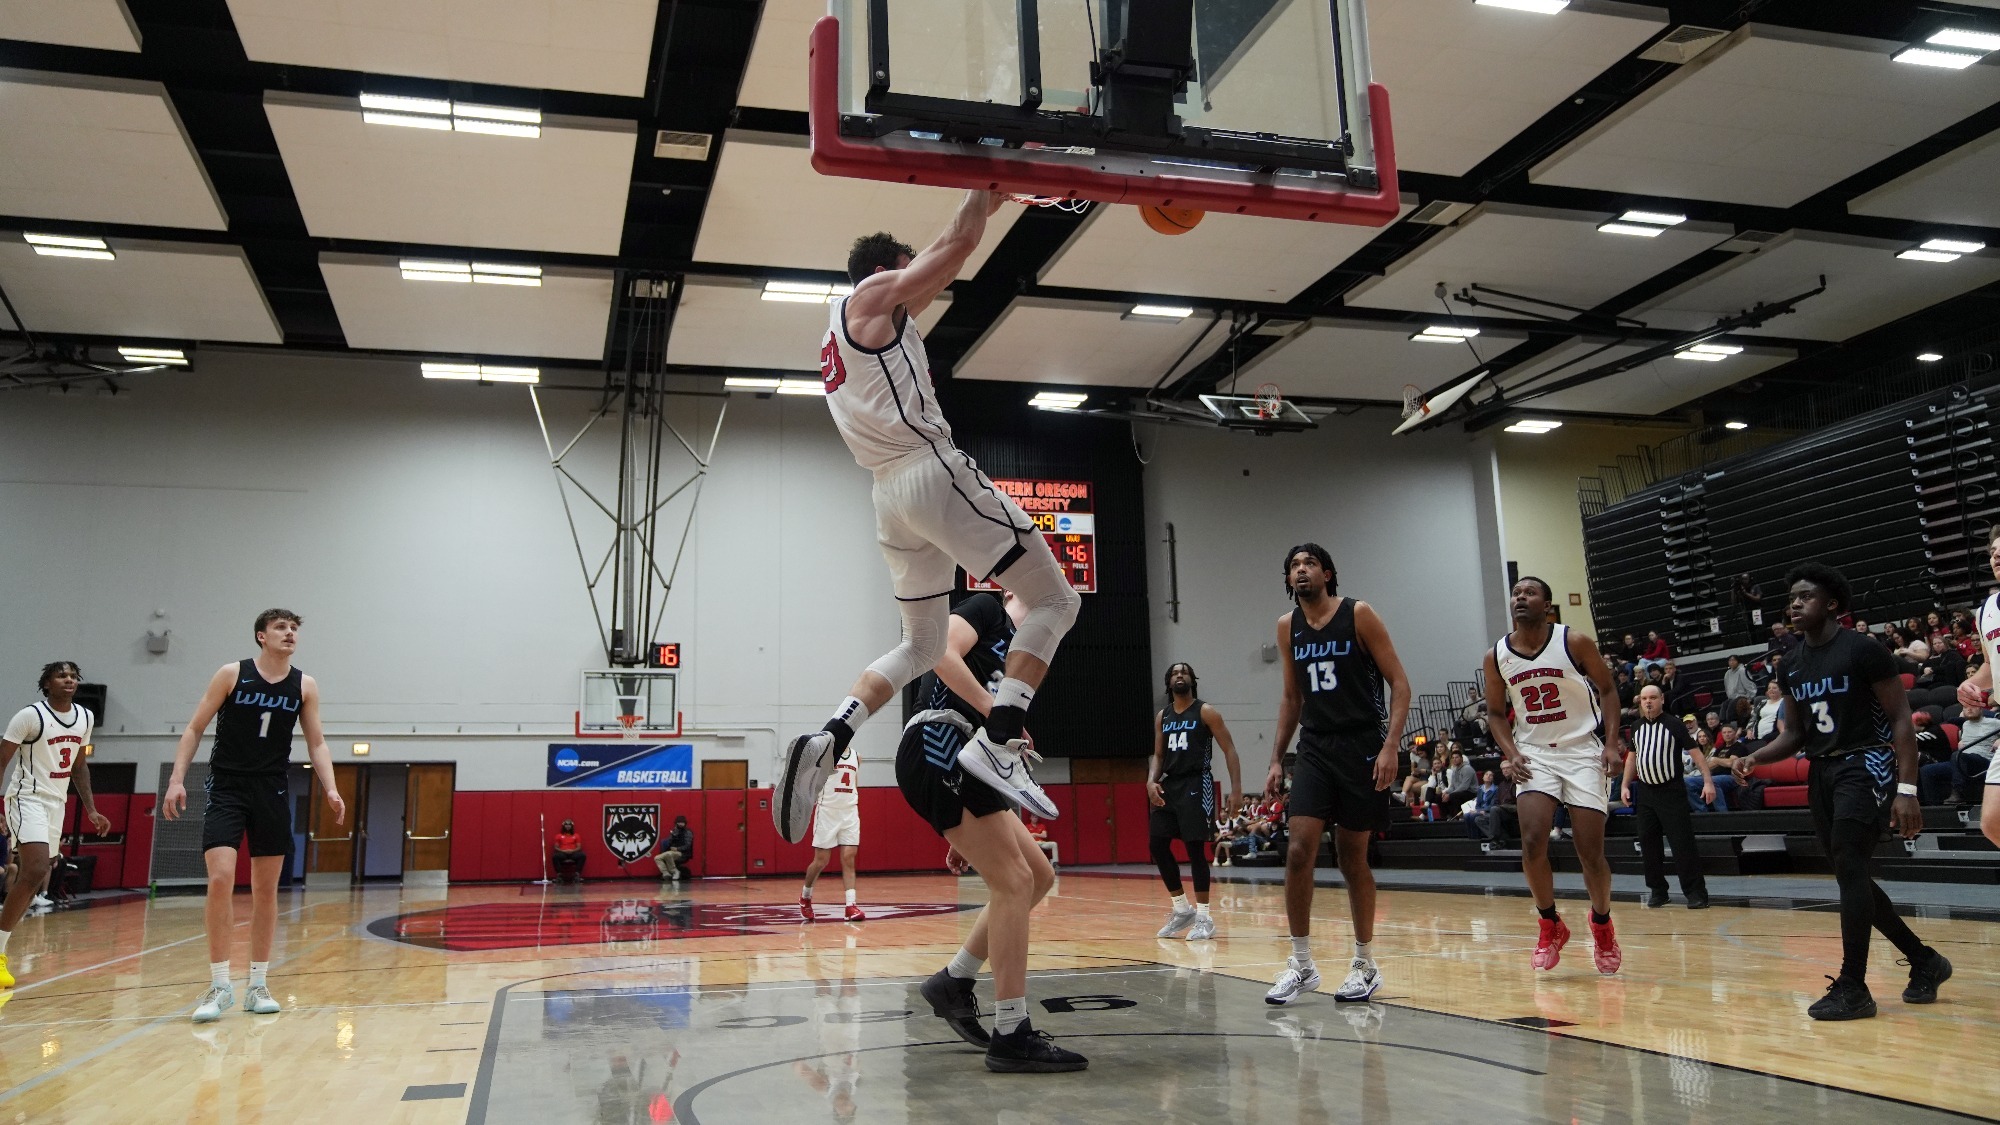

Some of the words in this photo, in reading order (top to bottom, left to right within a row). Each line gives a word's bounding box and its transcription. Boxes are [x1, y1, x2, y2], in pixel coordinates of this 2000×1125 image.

[1035, 482, 1088, 499] OREGON
[1066, 545, 1088, 562] 46
[660, 645, 678, 666] 16
[1293, 640, 1351, 661] WWU
[1307, 661, 1338, 692] 13
[1520, 682, 1562, 712] 22
[1789, 675, 1849, 702] WWU
[235, 690, 300, 712] WWU
[259, 711, 272, 738] 1
[1162, 720, 1197, 733] WWU
[1810, 701, 1835, 734] 3
[1167, 731, 1189, 752] 44
[59, 747, 72, 769] 3
[557, 759, 599, 767] NCAA.com
[616, 770, 688, 784] BASKETBALL
[840, 771, 851, 787] 4
